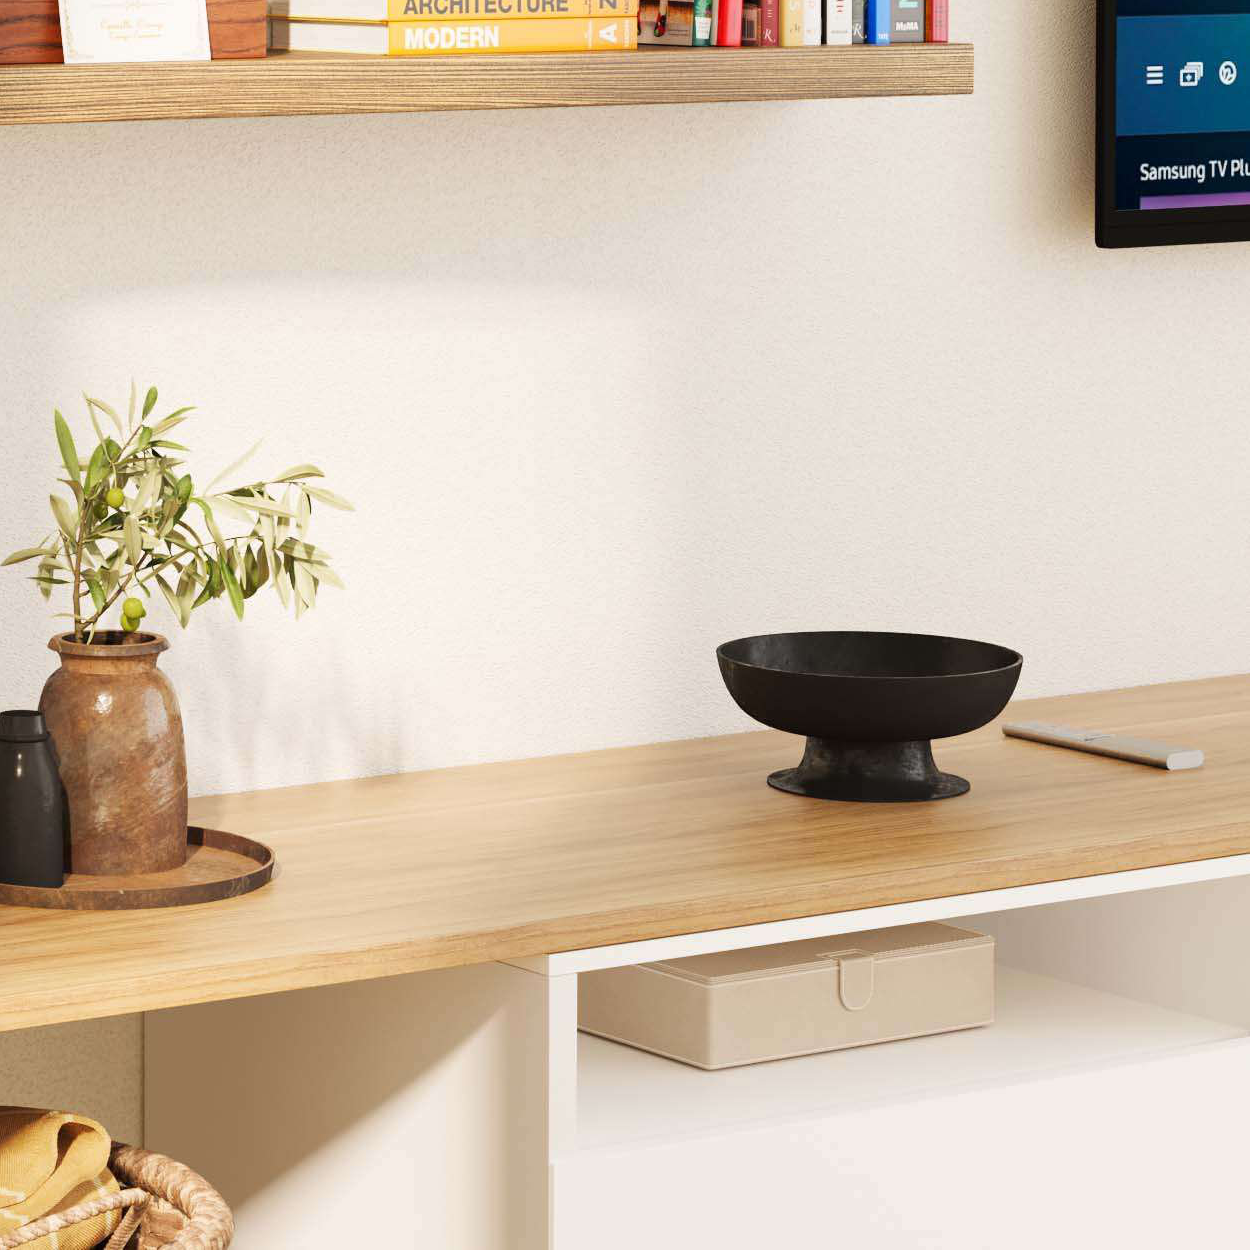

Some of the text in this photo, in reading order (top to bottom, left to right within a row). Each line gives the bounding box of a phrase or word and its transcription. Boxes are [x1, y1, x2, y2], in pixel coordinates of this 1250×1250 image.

[599, 24, 617, 43] A
[895, 21, 918, 31] MoMA
[404, 25, 499, 49] MODERN
[1140, 162, 1206, 183] Samsung
[1208, 160, 1228, 178] TV
